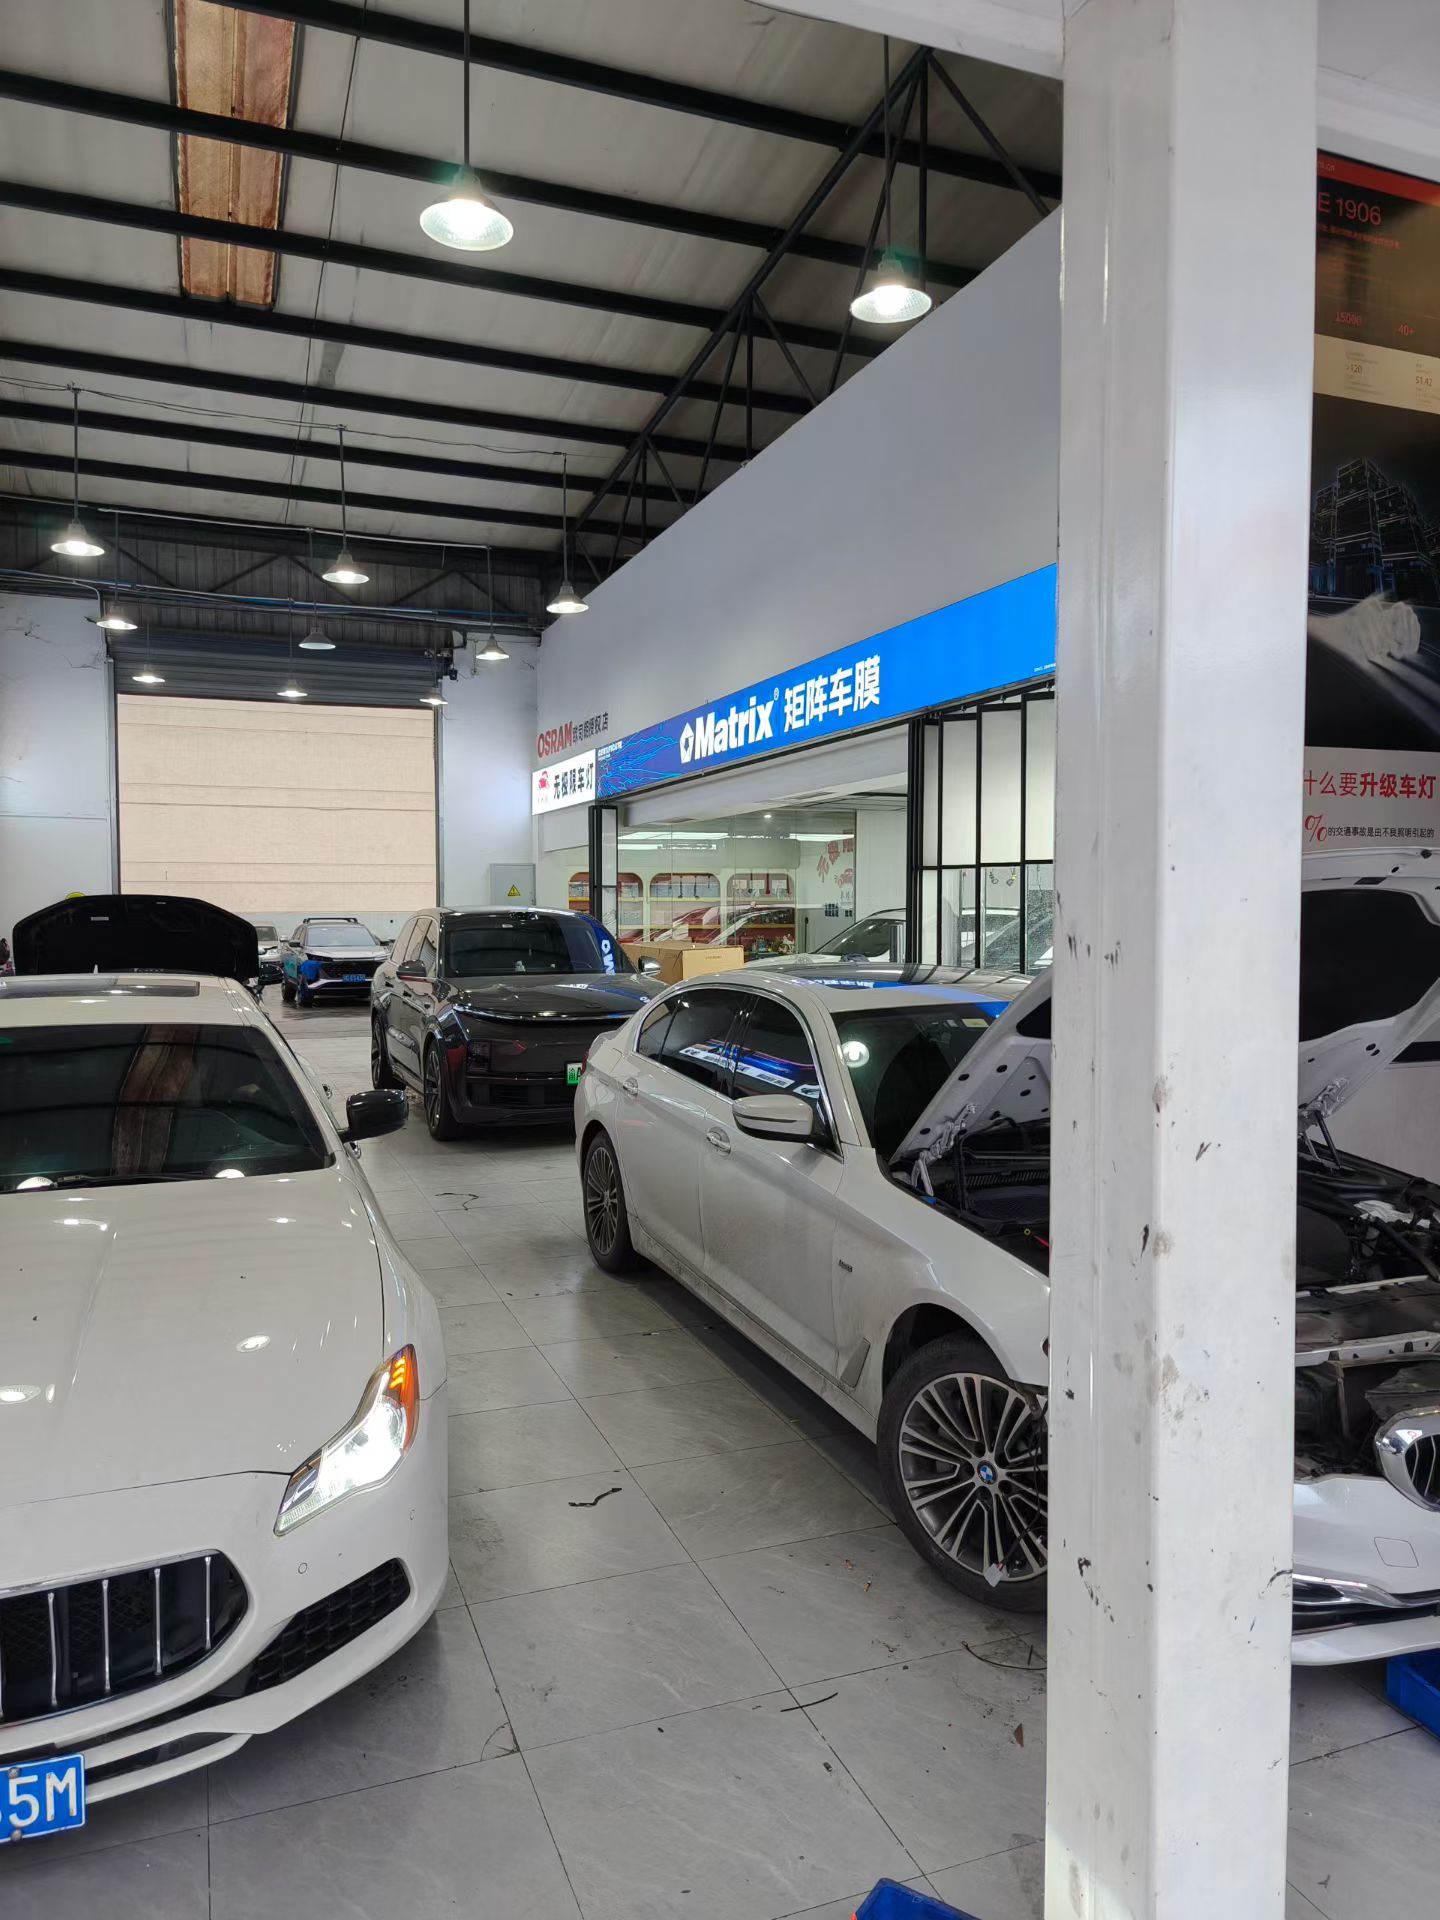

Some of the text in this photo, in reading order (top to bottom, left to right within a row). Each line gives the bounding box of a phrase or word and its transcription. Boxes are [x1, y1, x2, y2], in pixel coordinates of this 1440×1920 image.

[1336, 198, 1382, 226] 1906
[694, 654, 880, 761] Matrix 矩阵车膜
[537, 721, 573, 758] OSRAM
[553, 762, 594, 800] 无极限车灯
